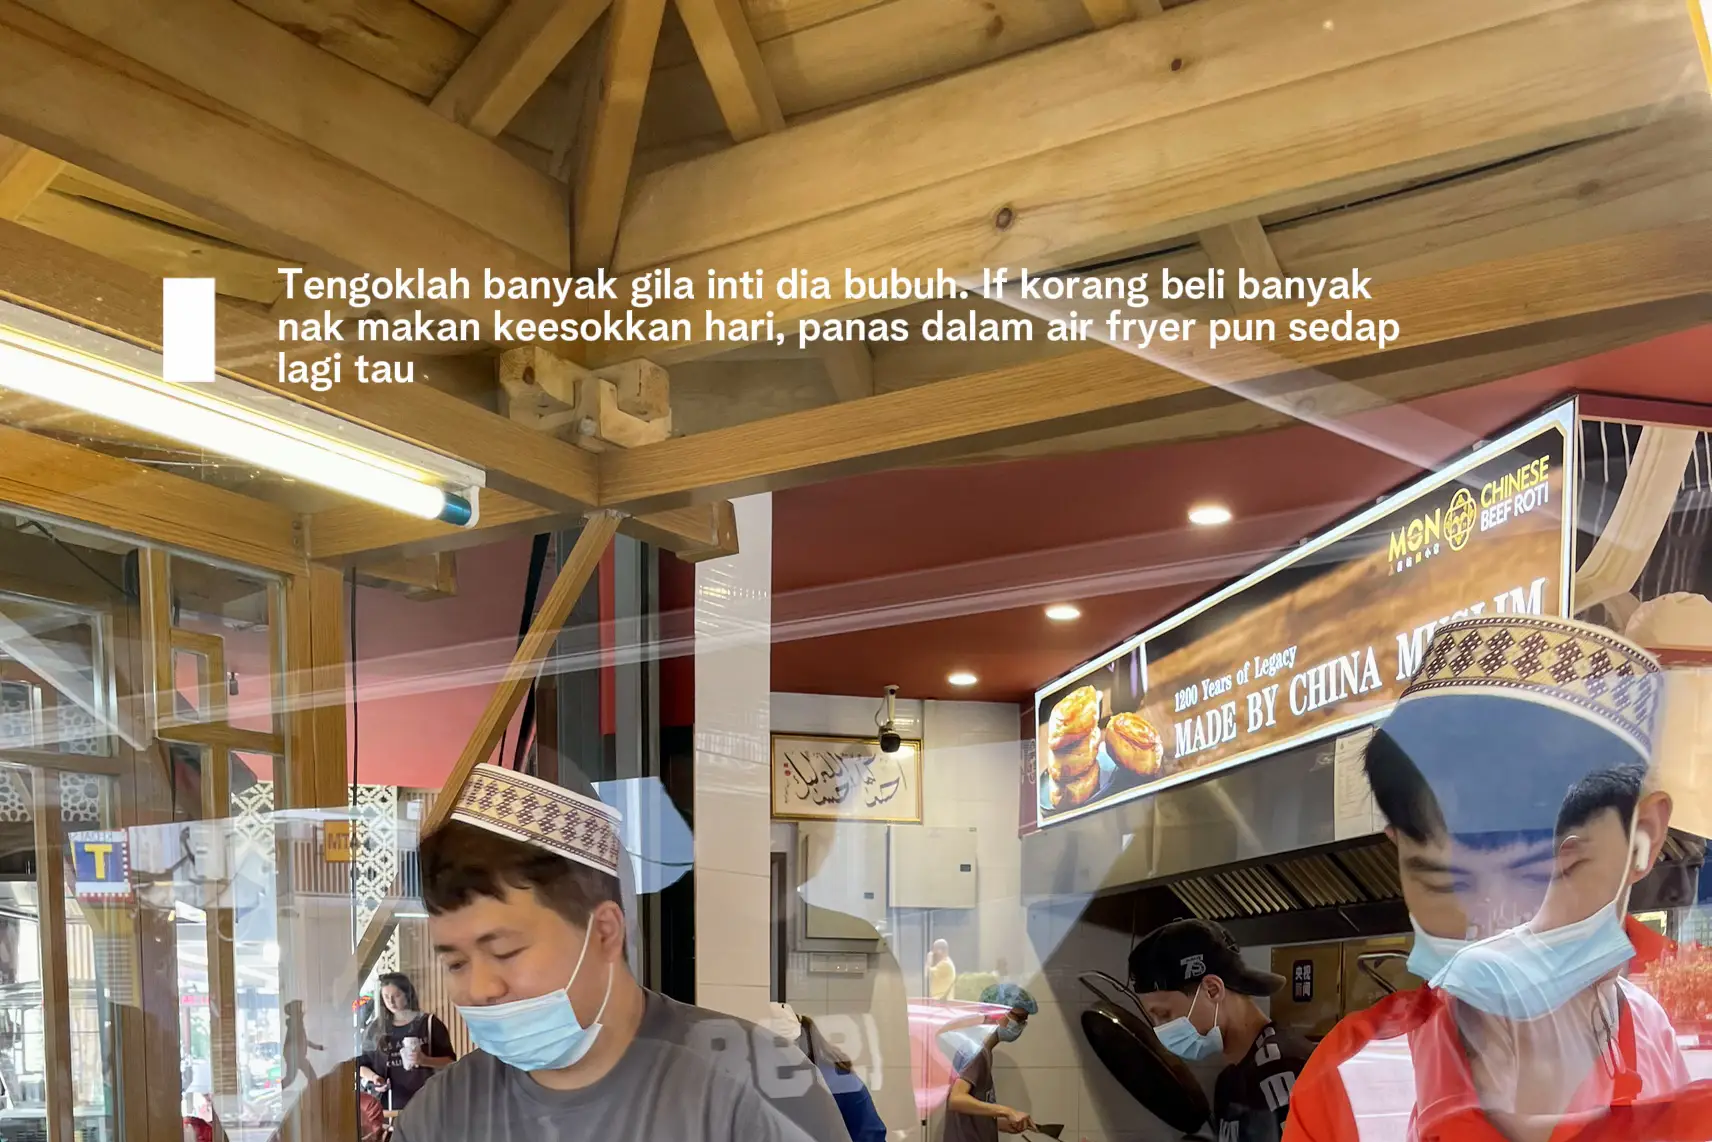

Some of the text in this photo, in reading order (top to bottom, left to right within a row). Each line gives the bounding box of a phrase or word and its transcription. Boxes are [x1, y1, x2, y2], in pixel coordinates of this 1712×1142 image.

[1480, 455, 1549, 508] CHINESE
[1480, 481, 1549, 532] BEEF ROTI
[1174, 577, 1546, 758] MADE BY CHINA MIM
[1174, 645, 1298, 713] 1200 Years of Legacy
